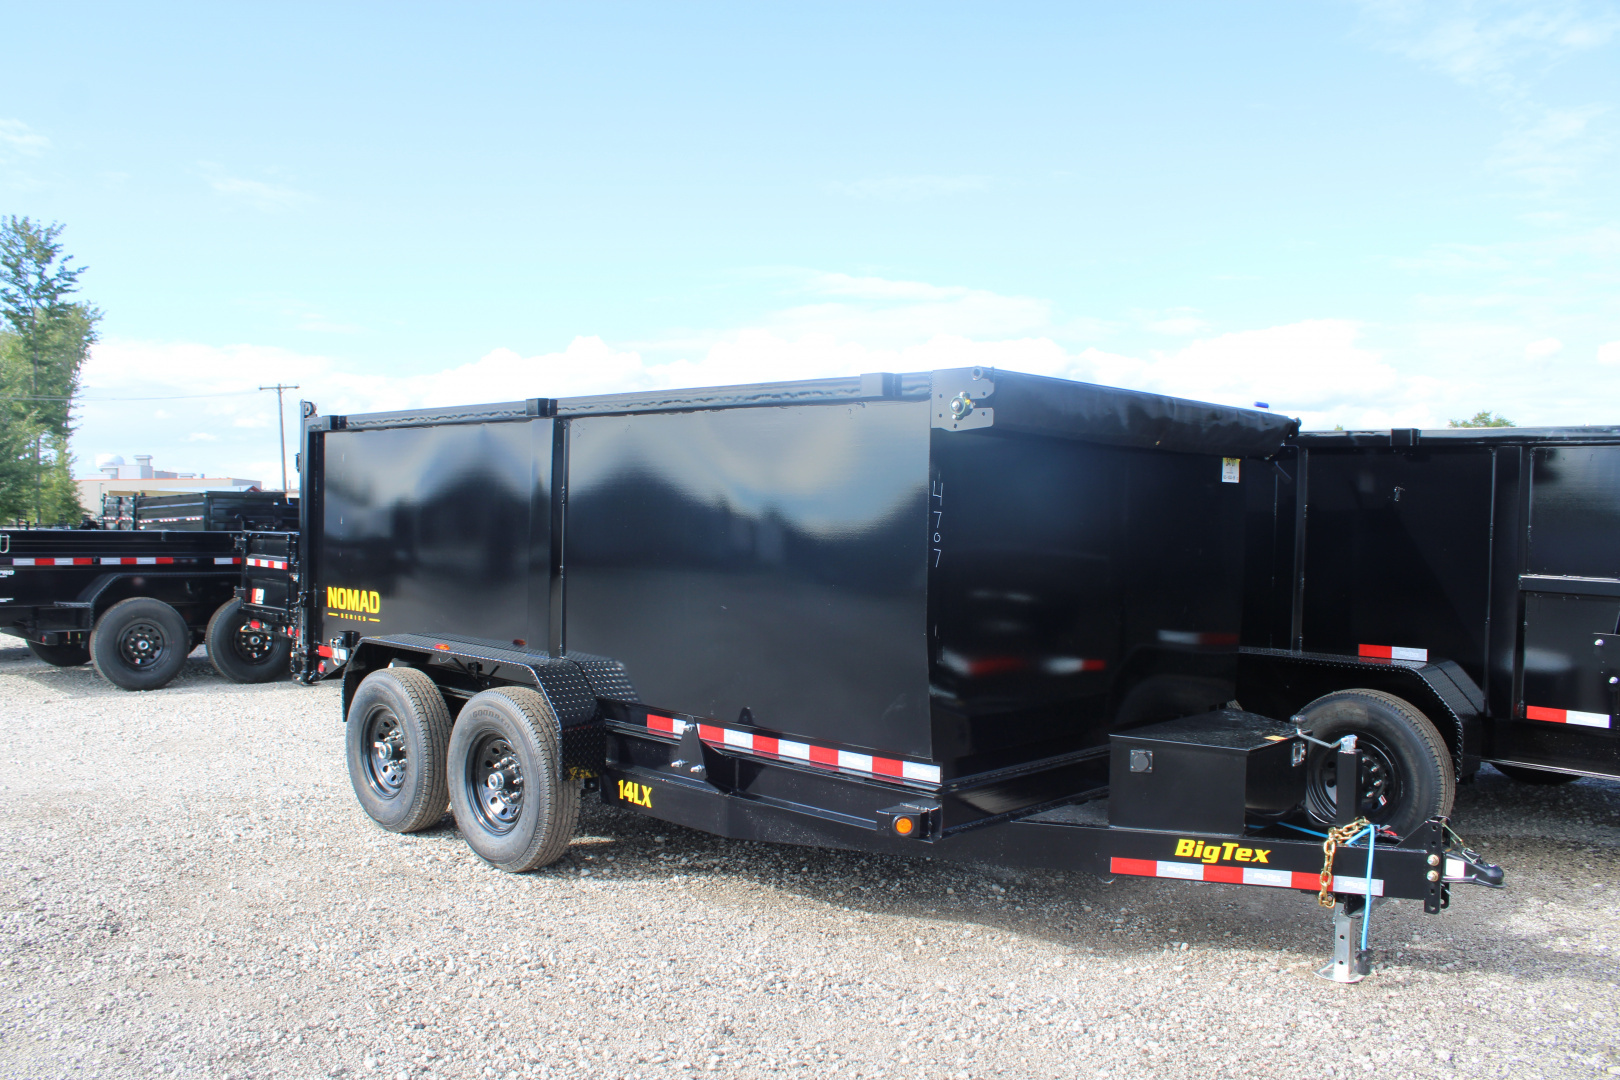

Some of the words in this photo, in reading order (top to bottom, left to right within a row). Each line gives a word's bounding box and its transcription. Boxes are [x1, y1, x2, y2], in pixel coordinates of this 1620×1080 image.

[327, 586, 381, 614] NOMAD
[340, 613, 367, 622] SERIES
[618, 779, 653, 809] 14LX
[1174, 838, 1272, 864] BigTex
